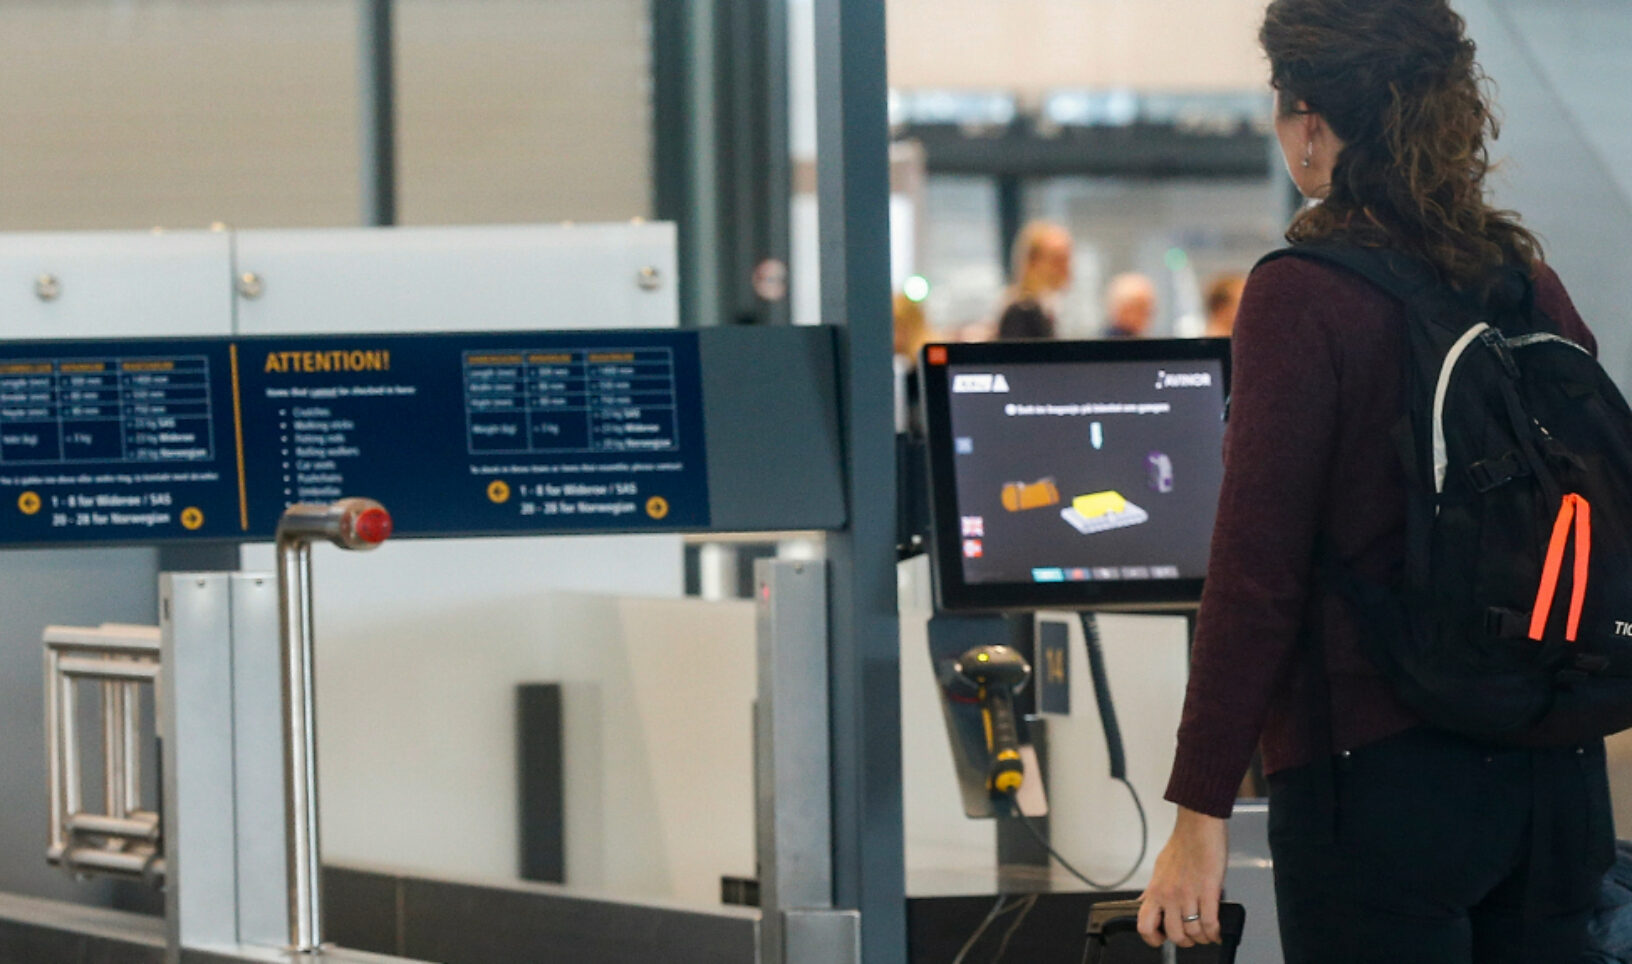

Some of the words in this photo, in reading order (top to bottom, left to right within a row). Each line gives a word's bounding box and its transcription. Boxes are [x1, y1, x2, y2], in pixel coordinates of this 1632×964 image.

[265, 350, 390, 373] ATTENTION!
[520, 485, 527, 496] 1
[544, 484, 562, 496] for
[616, 482, 638, 495] SAS
[51, 495, 58, 507] 1
[78, 494, 94, 507] for
[149, 492, 173, 506] SAS
[520, 502, 535, 515] 20
[543, 502, 558, 514] 28
[559, 501, 576, 514] for
[577, 500, 636, 516] Norwegian
[52, 513, 67, 527] 20
[75, 512, 90, 526] 28
[92, 511, 109, 525] for
[110, 510, 171, 527] Norwegian
